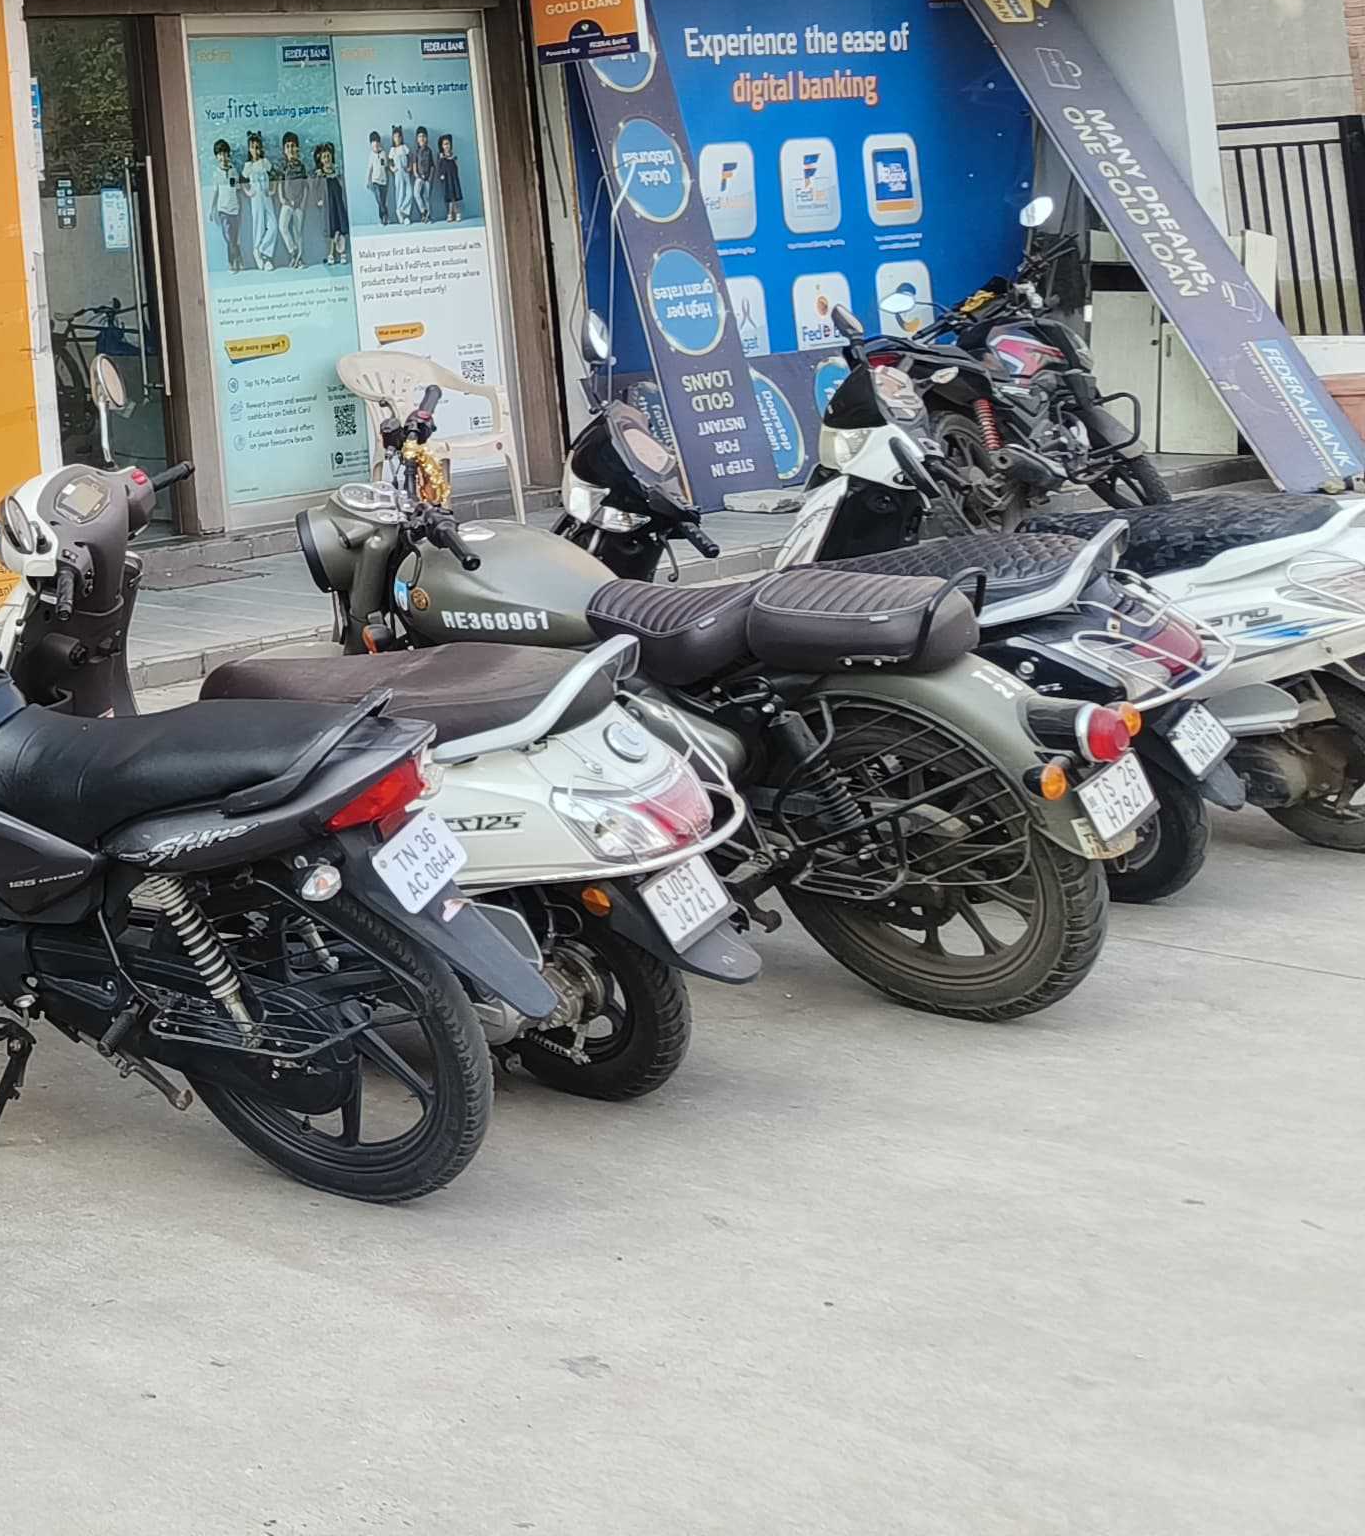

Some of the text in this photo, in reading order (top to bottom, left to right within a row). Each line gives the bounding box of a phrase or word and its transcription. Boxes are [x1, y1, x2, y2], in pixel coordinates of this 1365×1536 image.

[545, 0, 579, 15] GOLD
[684, 22, 911, 65] Experience the ease of
[343, 74, 470, 98] Your first banking partner
[732, 70, 880, 112] digital banking
[204, 98, 329, 123] Your first banking partner
[638, 168, 671, 186] Quick
[1063, 104, 1201, 299] ONE GOLD LOAN
[1087, 108, 1217, 293] MANY DREAMS,
[681, 370, 734, 393] LOANS
[691, 391, 735, 412] GOLD
[697, 416, 747, 437] INSTANT
[761, 390, 792, 452] Doorstep
[1263, 344, 1351, 471] FEDERAL BANK
[713, 438, 741, 454] FOR
[441, 609, 550, 631] RE368961
[1093, 758, 1139, 804] TS 26
[391, 826, 439, 872] TN 36
[407, 848, 457, 902] AC 0644
[676, 889, 717, 932] J4743
